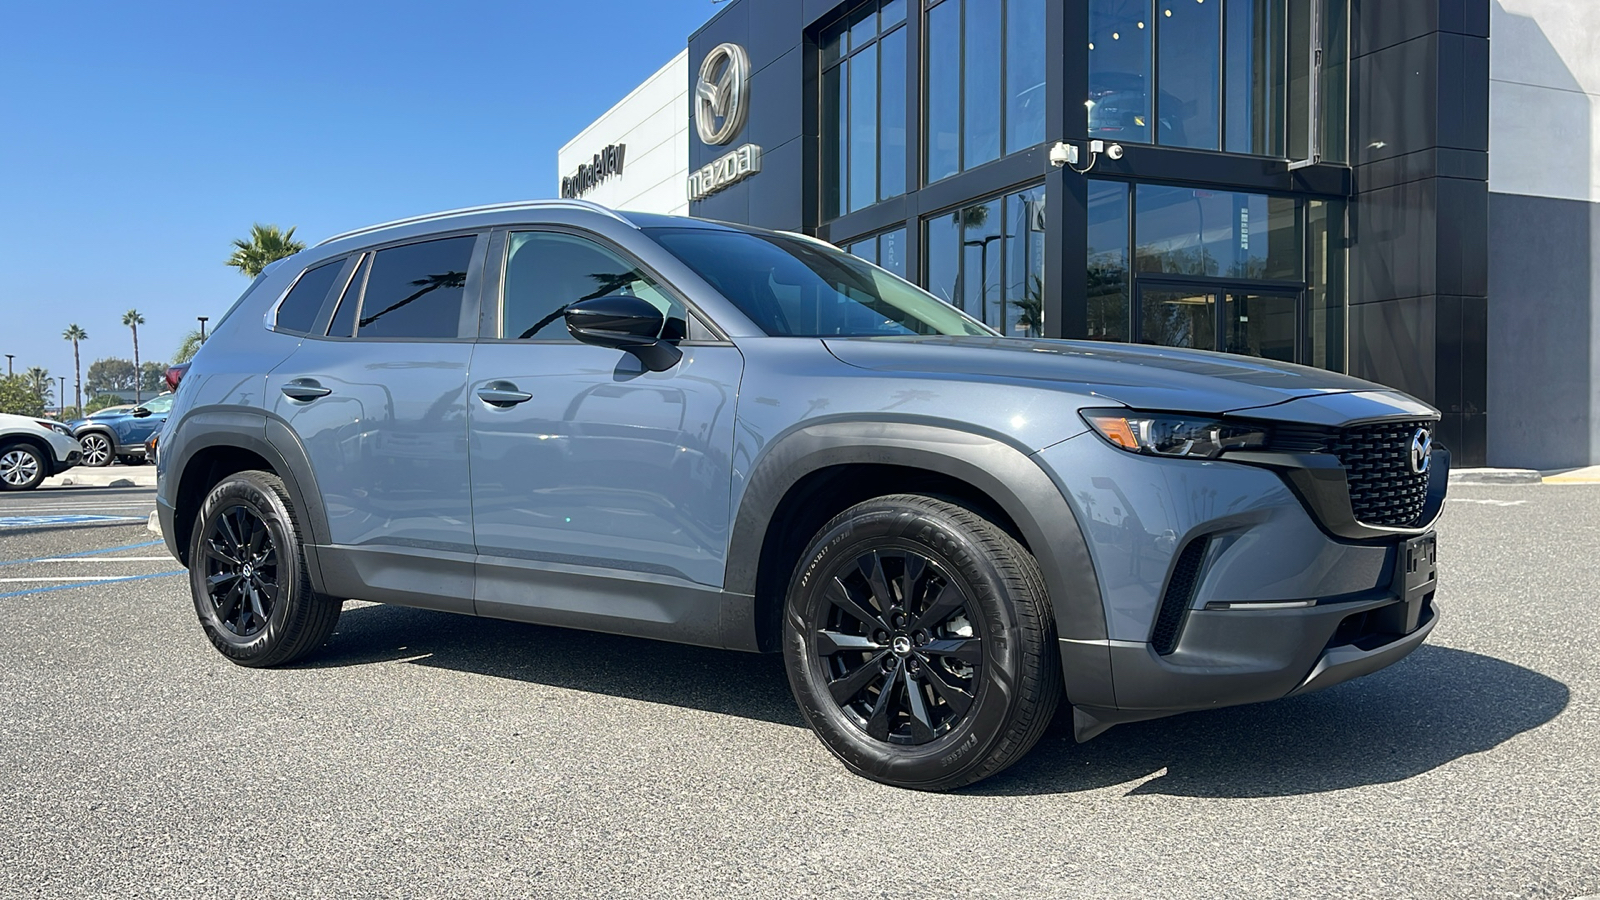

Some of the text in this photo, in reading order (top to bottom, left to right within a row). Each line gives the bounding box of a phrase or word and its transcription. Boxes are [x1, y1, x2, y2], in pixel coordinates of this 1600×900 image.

[209, 483, 265, 510] ASSURANCE
[916, 526, 1007, 649] ASSURANCE
[940, 732, 979, 768] FINESSE
